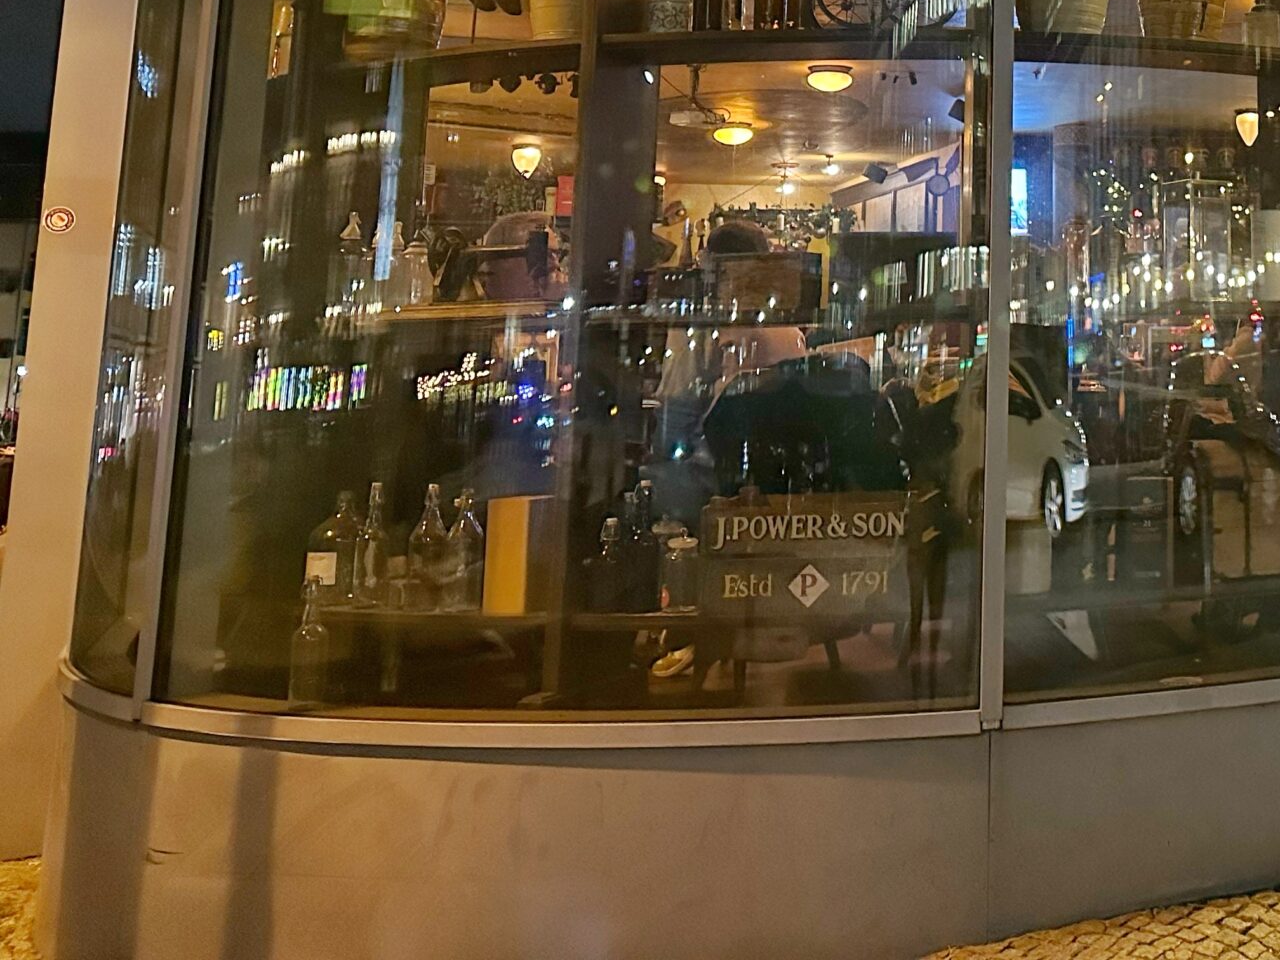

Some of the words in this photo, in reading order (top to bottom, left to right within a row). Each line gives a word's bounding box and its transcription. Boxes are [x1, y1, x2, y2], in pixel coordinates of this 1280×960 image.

[712, 514, 824, 551] J.POWER
[826, 512, 849, 538] &
[722, 572, 773, 599] Estd
[799, 573, 818, 598] P
[841, 570, 889, 596] 1791
